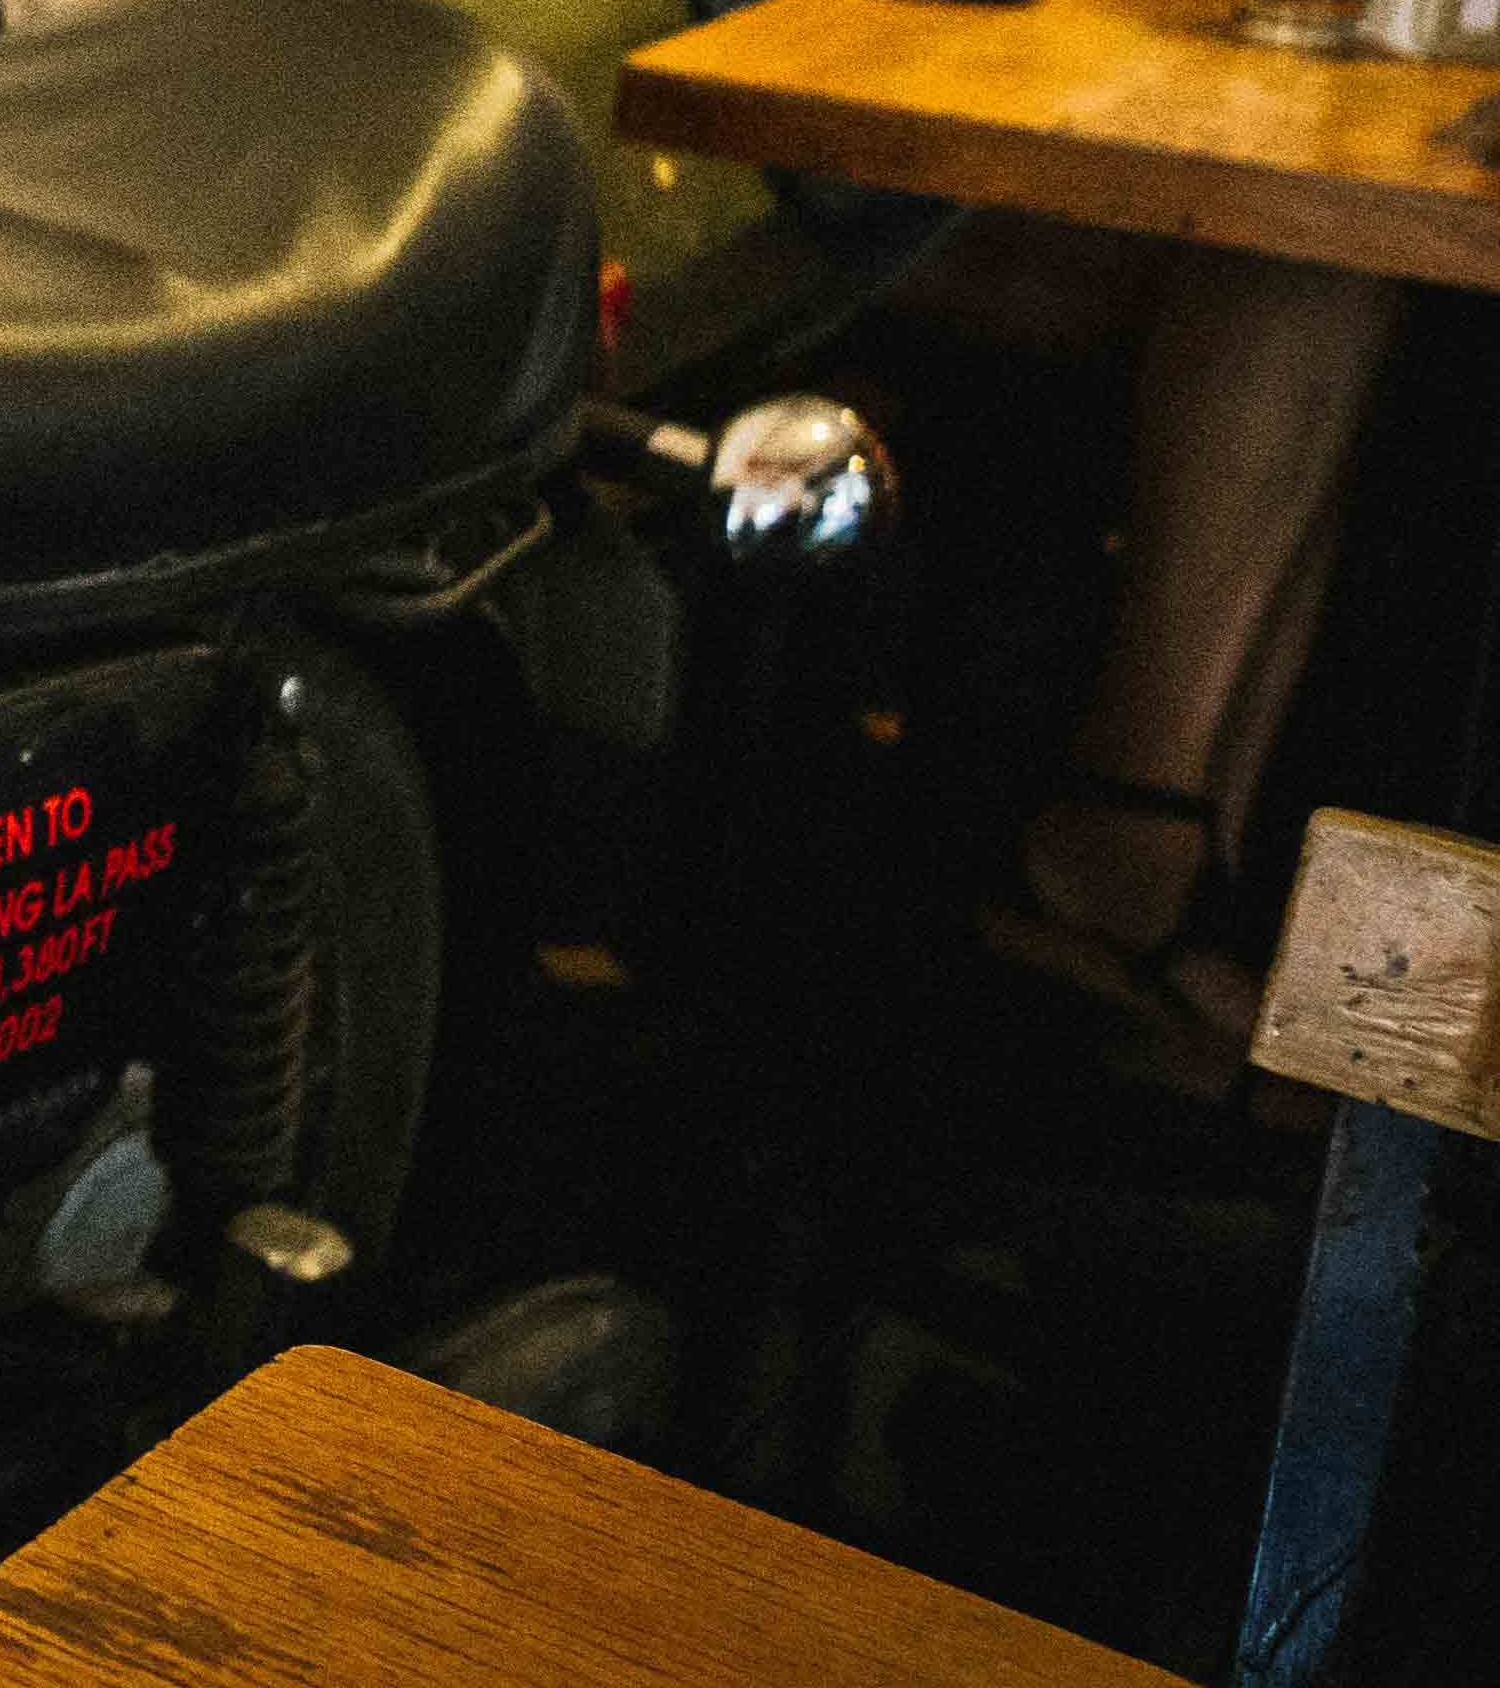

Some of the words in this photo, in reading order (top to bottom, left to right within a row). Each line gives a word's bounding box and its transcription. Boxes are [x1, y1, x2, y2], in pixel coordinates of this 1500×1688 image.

[44, 787, 92, 846] TO
[53, 862, 92, 916] LA
[103, 823, 175, 892] PASS
